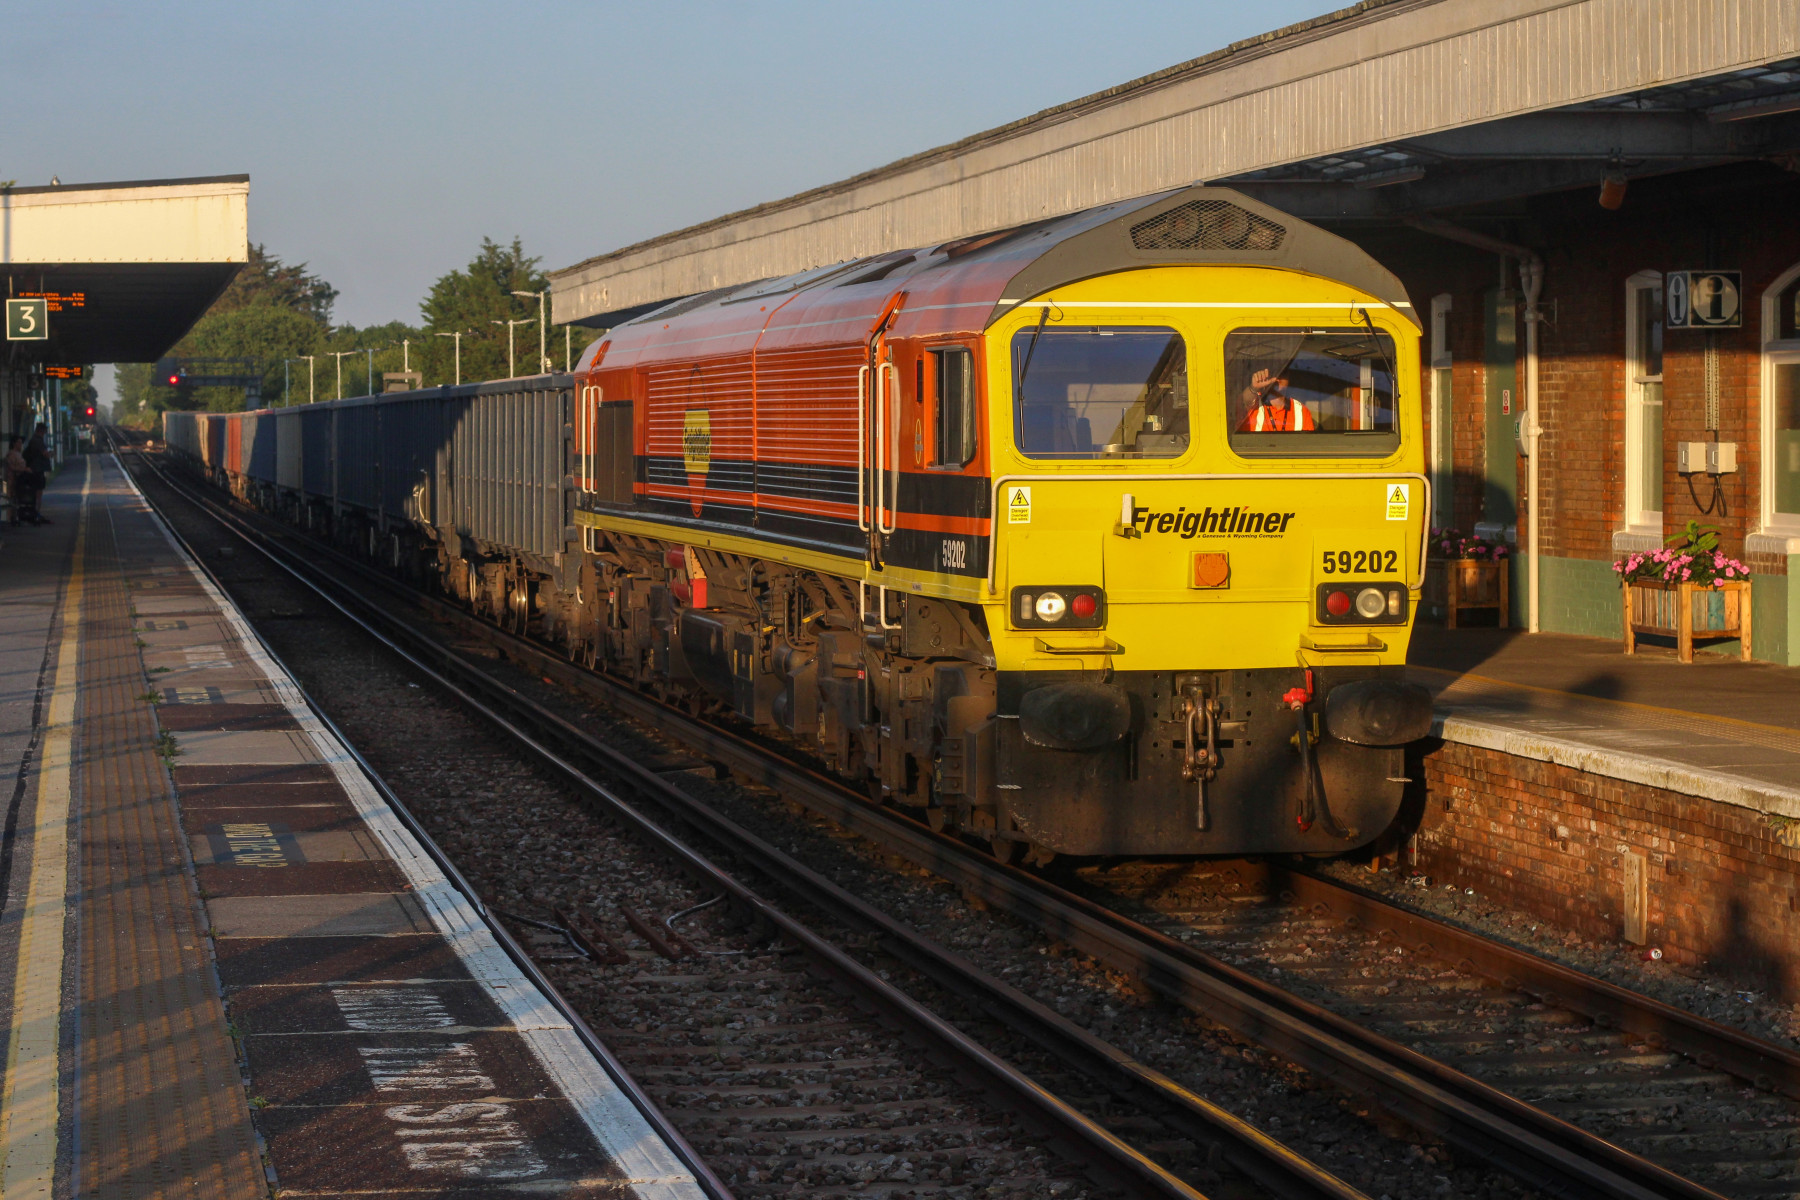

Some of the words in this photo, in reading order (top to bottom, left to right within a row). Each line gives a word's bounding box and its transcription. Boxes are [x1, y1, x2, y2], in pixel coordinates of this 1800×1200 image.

[19, 306, 36, 333] 3
[1133, 506, 1296, 540] Freightliner
[942, 539, 966, 569] 59202
[1322, 549, 1398, 574] 59202
[228, 838, 281, 852] THE
[233, 853, 289, 868] GAP
